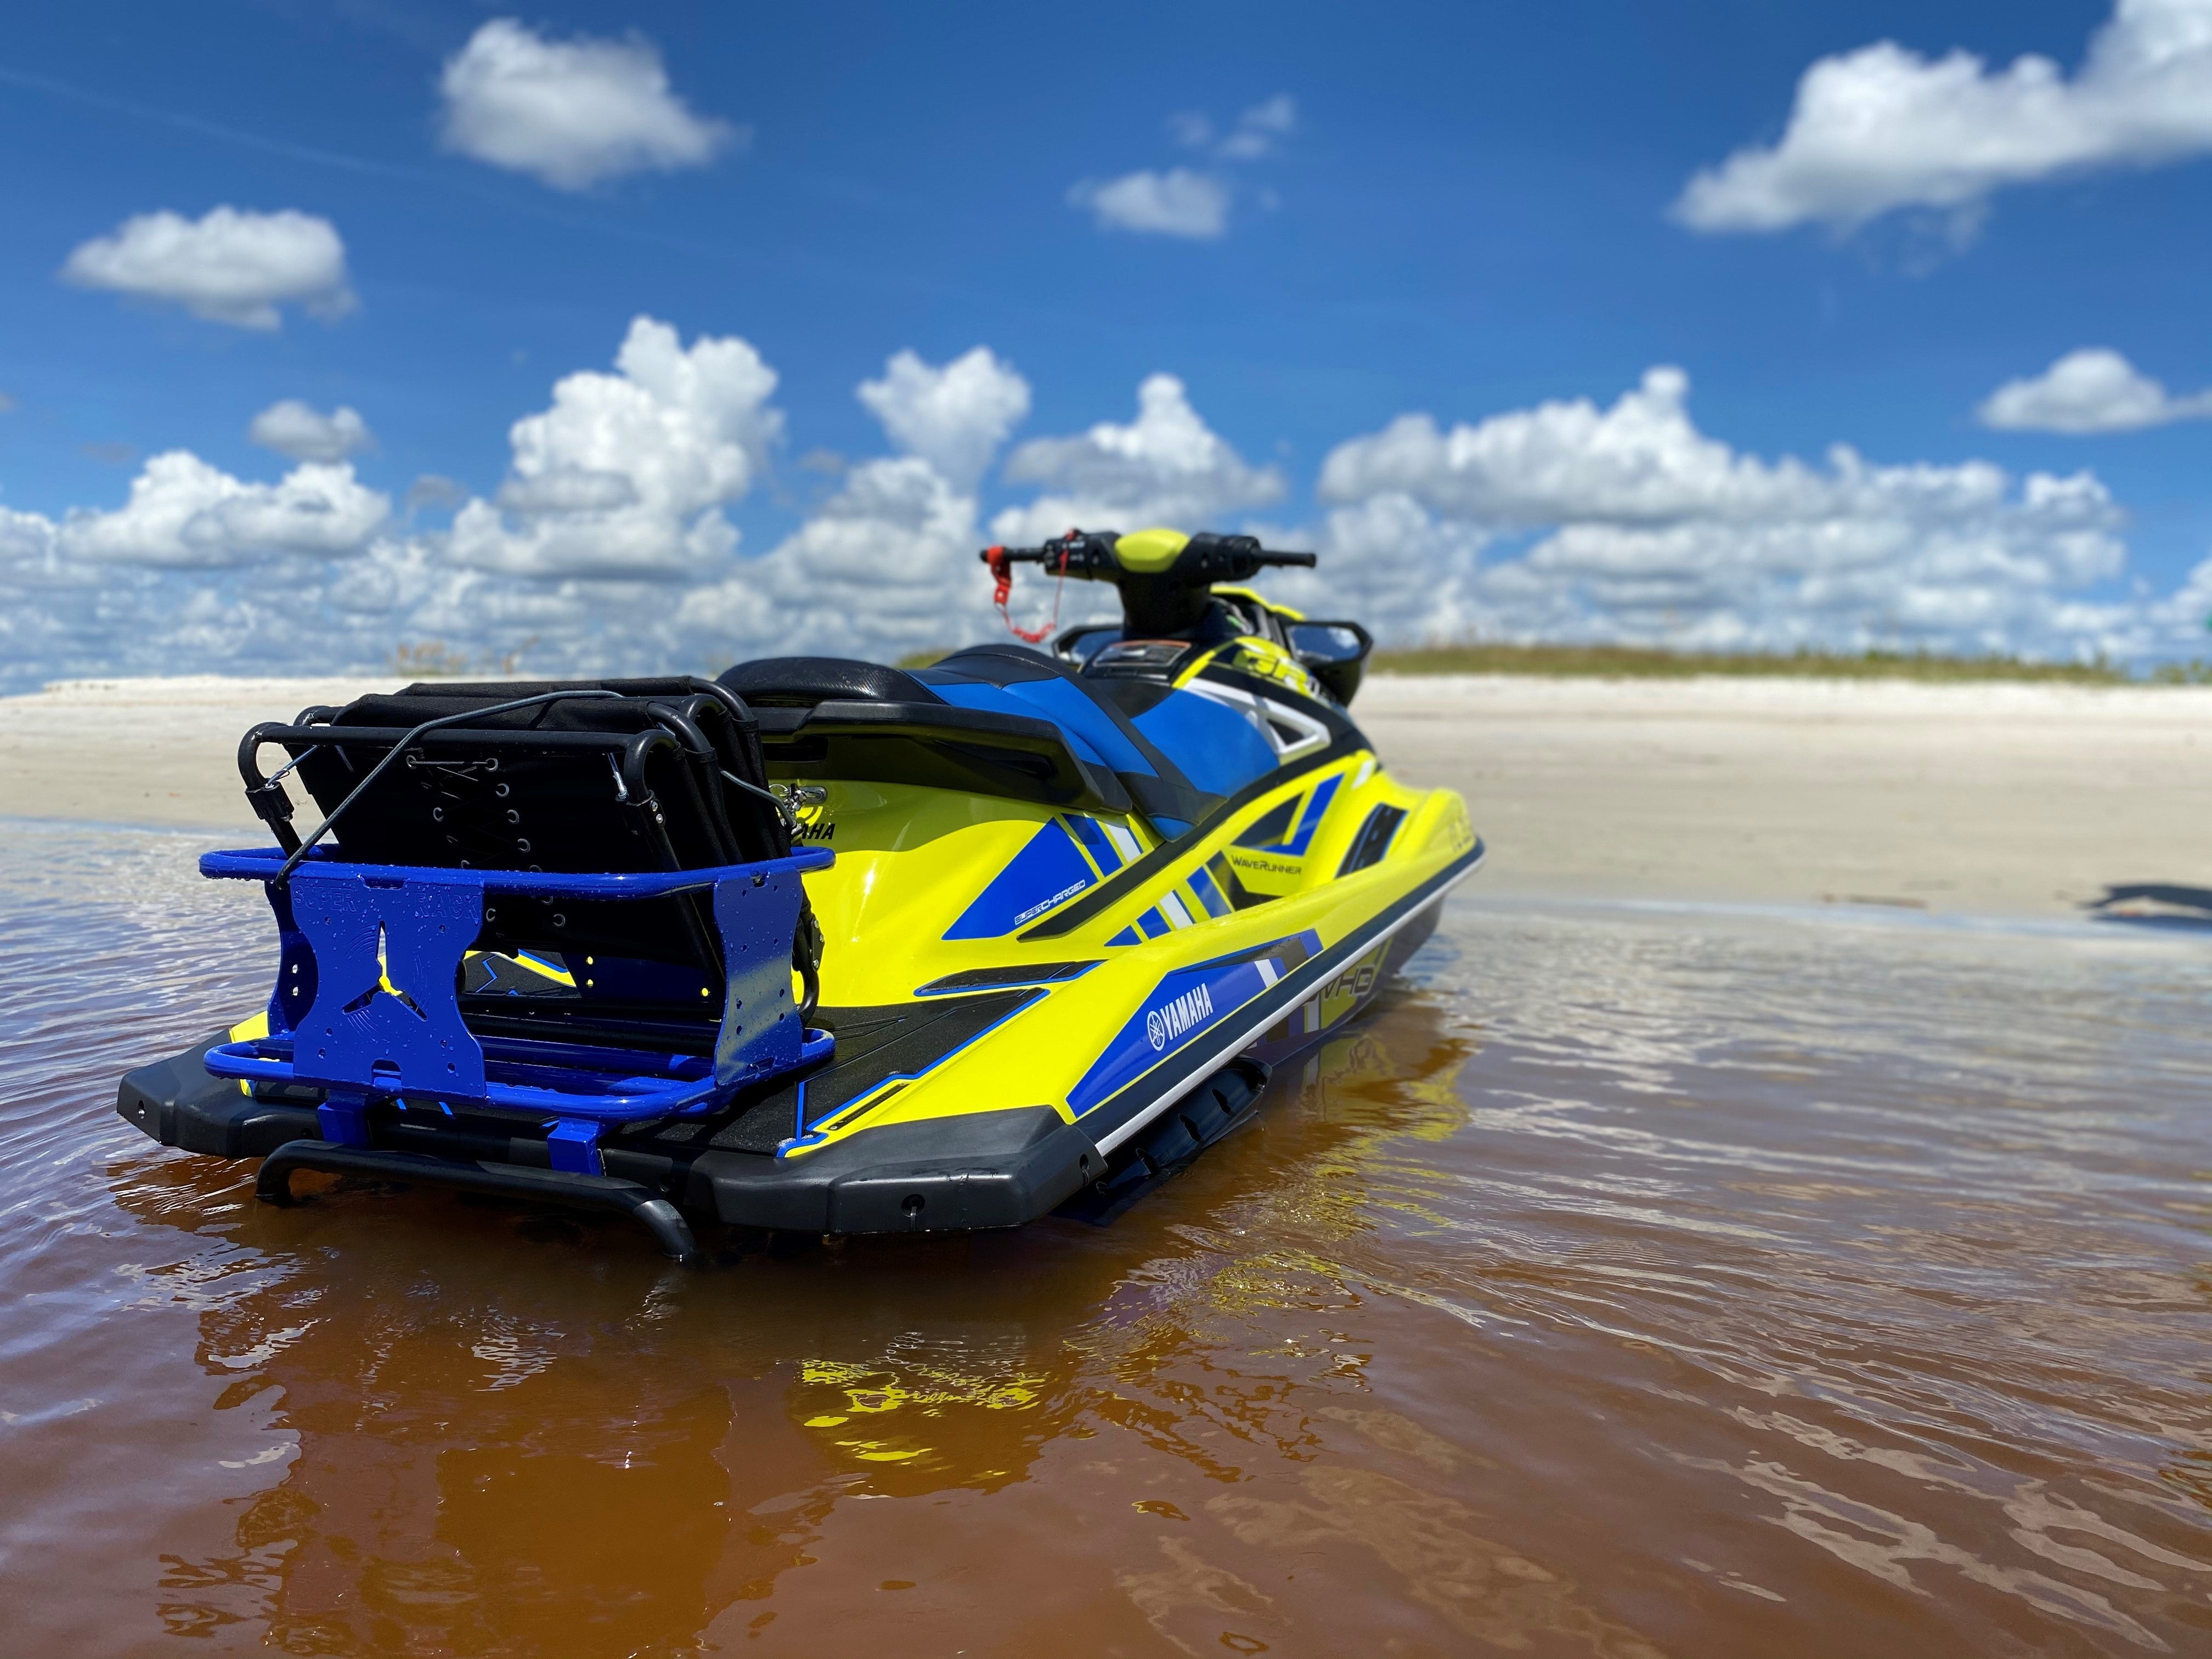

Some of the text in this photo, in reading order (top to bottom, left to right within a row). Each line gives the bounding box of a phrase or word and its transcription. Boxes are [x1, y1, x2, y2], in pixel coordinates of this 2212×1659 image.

[292, 884, 482, 920] SUPER RACK
[1014, 879, 1086, 926] SUPERCHARGED
[1159, 983, 1214, 1041] YAMAHA
